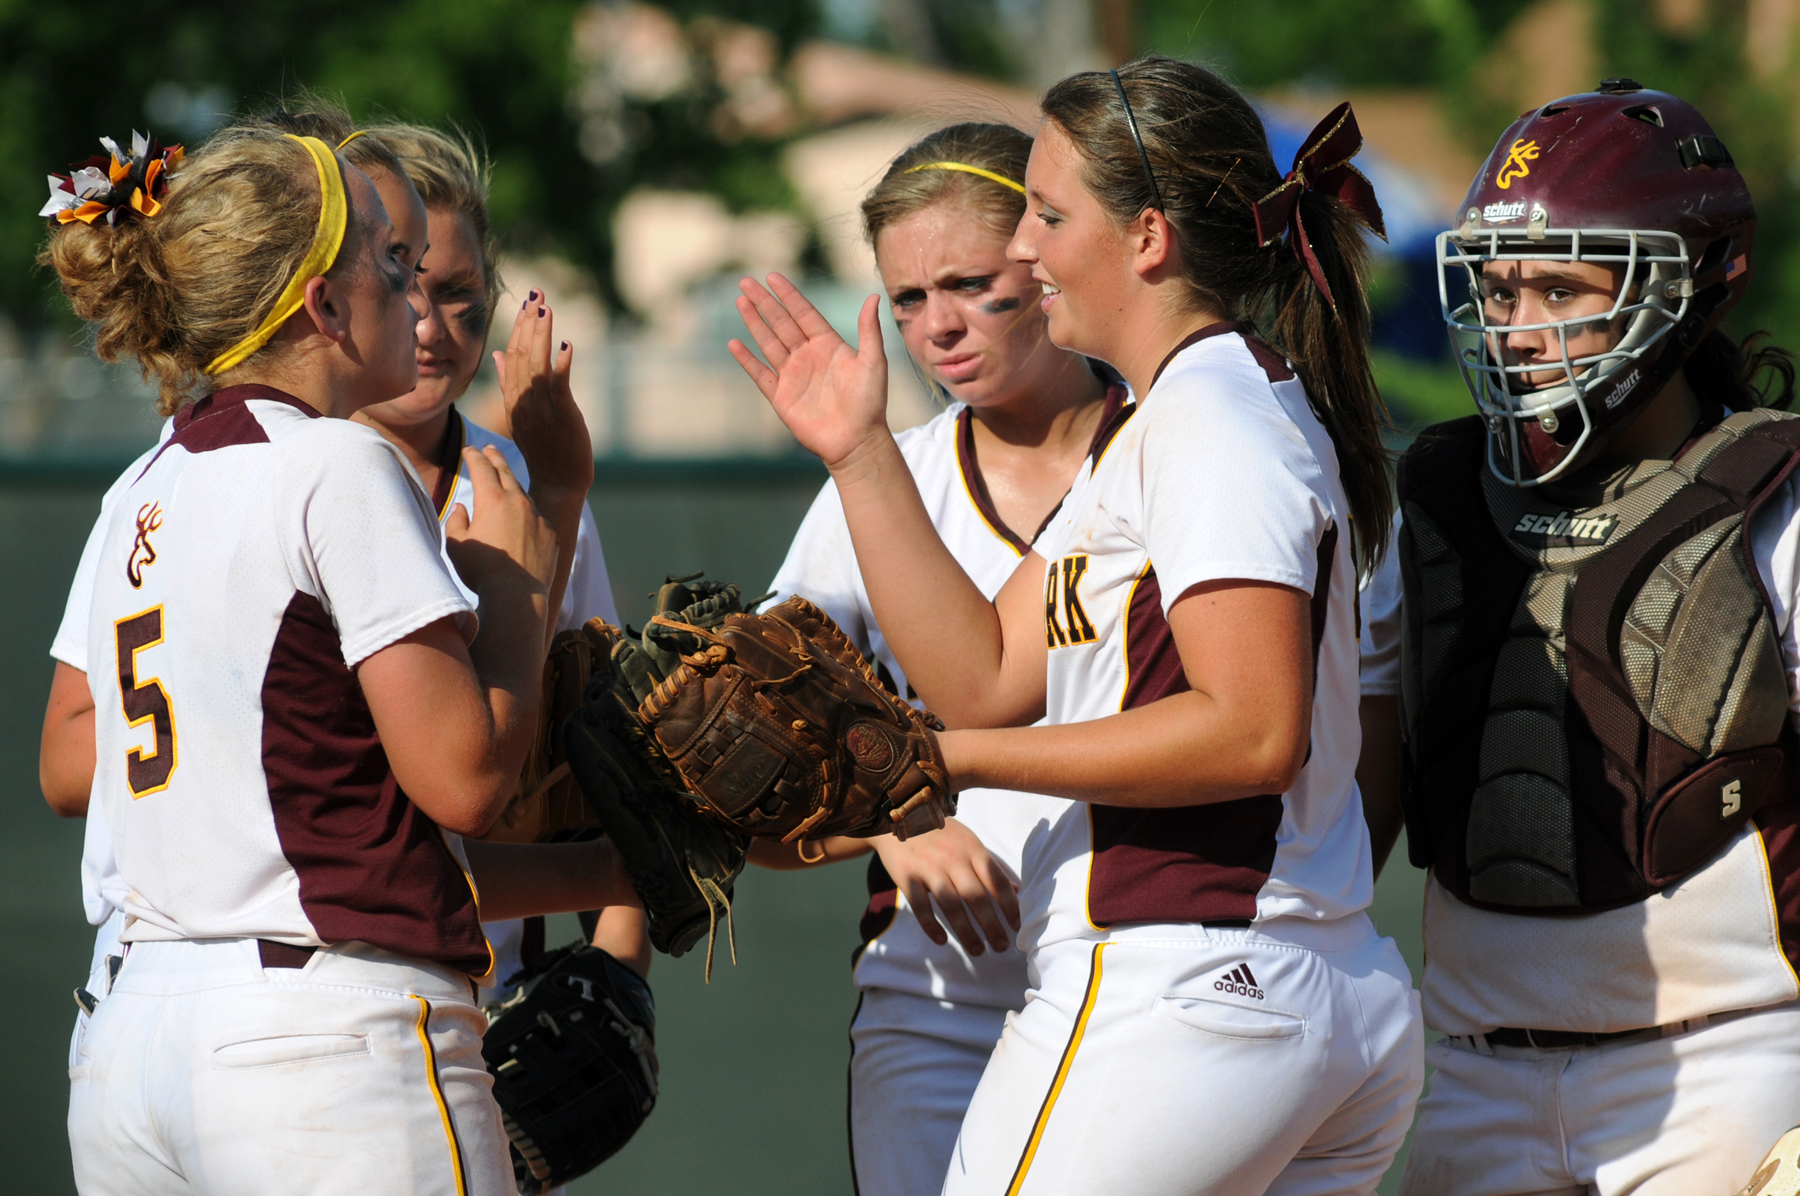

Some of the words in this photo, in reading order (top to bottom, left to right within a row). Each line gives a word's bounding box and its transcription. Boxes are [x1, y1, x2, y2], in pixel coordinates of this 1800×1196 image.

[1482, 200, 1525, 218] schutt
[1605, 368, 1641, 409] schutt
[1514, 511, 1612, 540] schutt
[113, 602, 178, 800] 5
[1722, 779, 1741, 818] S
[1213, 980, 1265, 1001] adidas
